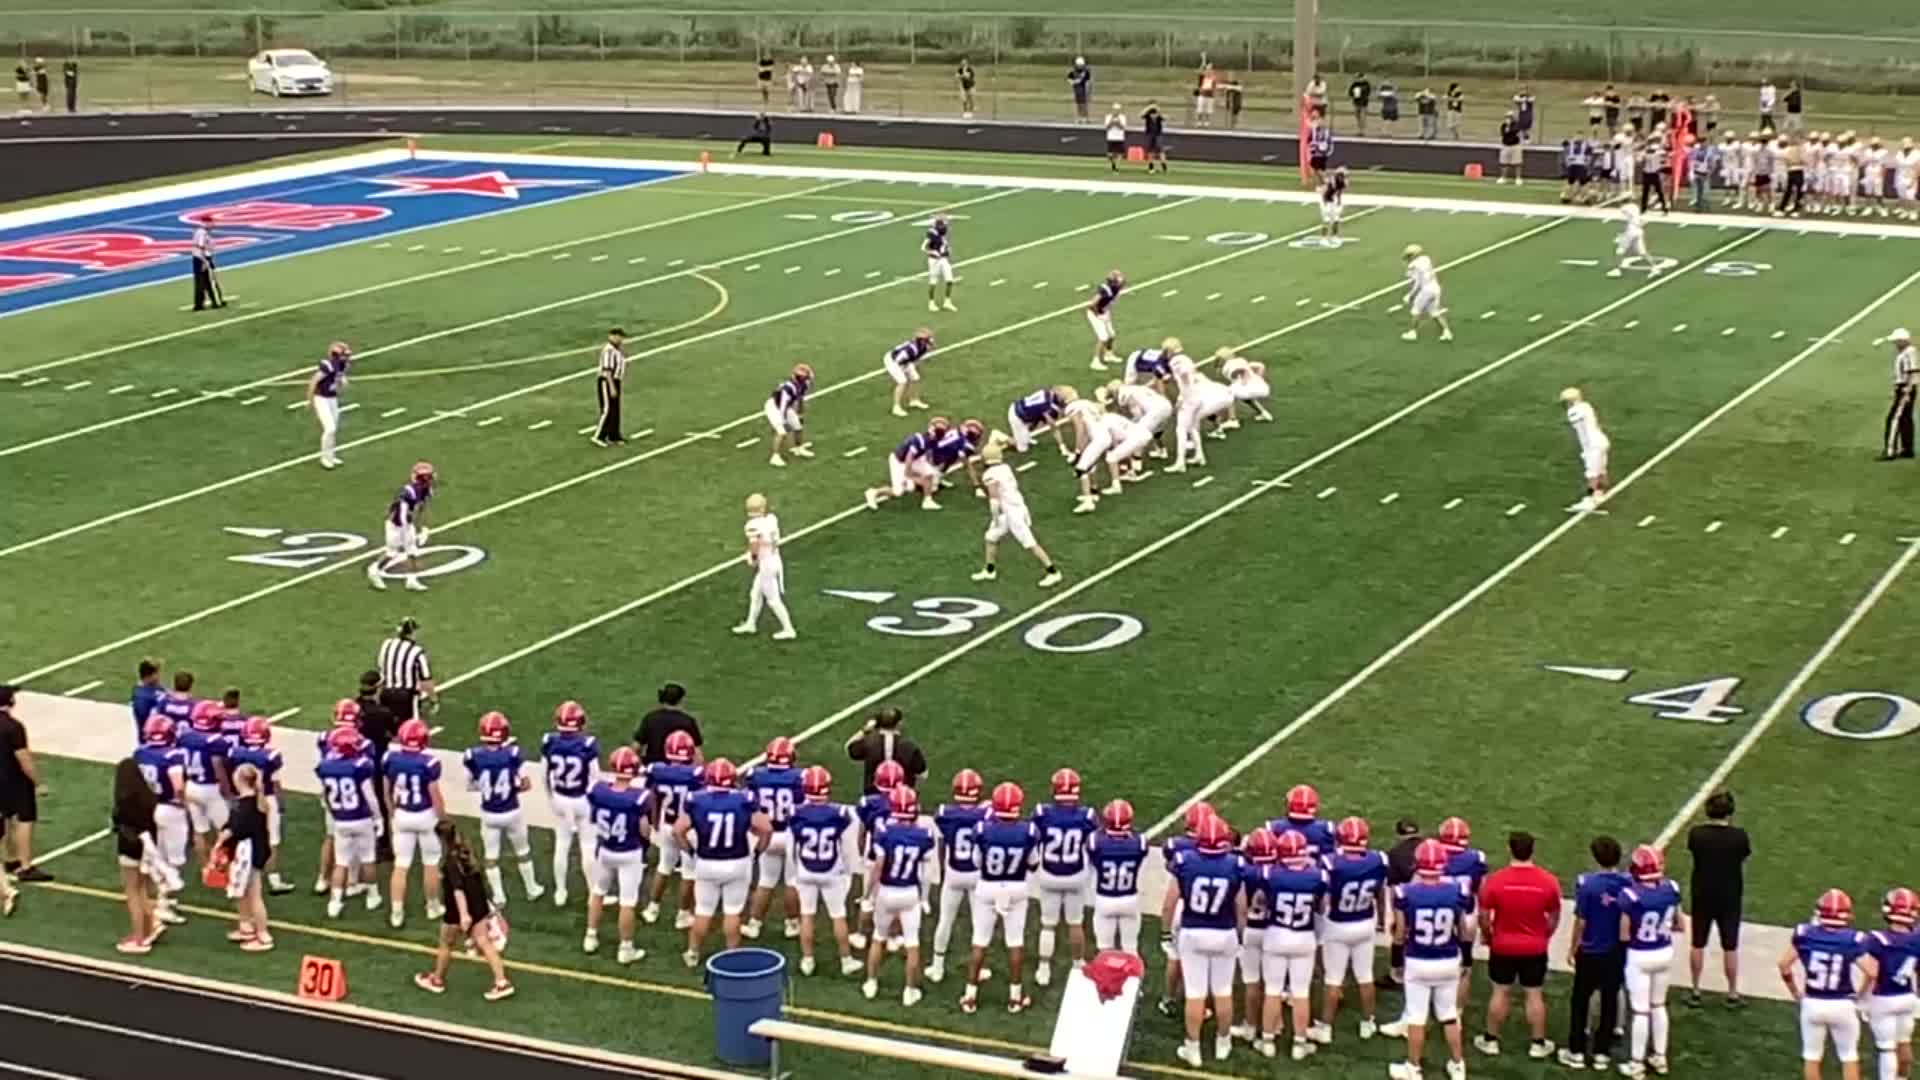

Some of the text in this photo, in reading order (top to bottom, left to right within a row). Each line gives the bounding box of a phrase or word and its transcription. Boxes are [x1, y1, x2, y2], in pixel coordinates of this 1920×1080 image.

[866, 597, 1144, 653] 30
[1625, 676, 1920, 739] 40
[393, 772, 423, 806] 41
[480, 769, 512, 801] 44
[549, 754, 582, 788] 22
[324, 777, 360, 811] 28
[596, 808, 628, 844] 54
[707, 811, 736, 848] 71
[801, 826, 836, 862] 26
[889, 844, 921, 880] 17
[986, 846, 1024, 876] 87
[1044, 826, 1082, 863] 20
[1100, 860, 1136, 891] 36
[1190, 876, 1230, 915] 67
[1275, 892, 1314, 928] 55
[1338, 879, 1377, 913] 66
[1414, 908, 1455, 946] 59
[1637, 905, 1675, 943] 84
[303, 961, 334, 997] 30
[1807, 950, 1844, 991] 51
